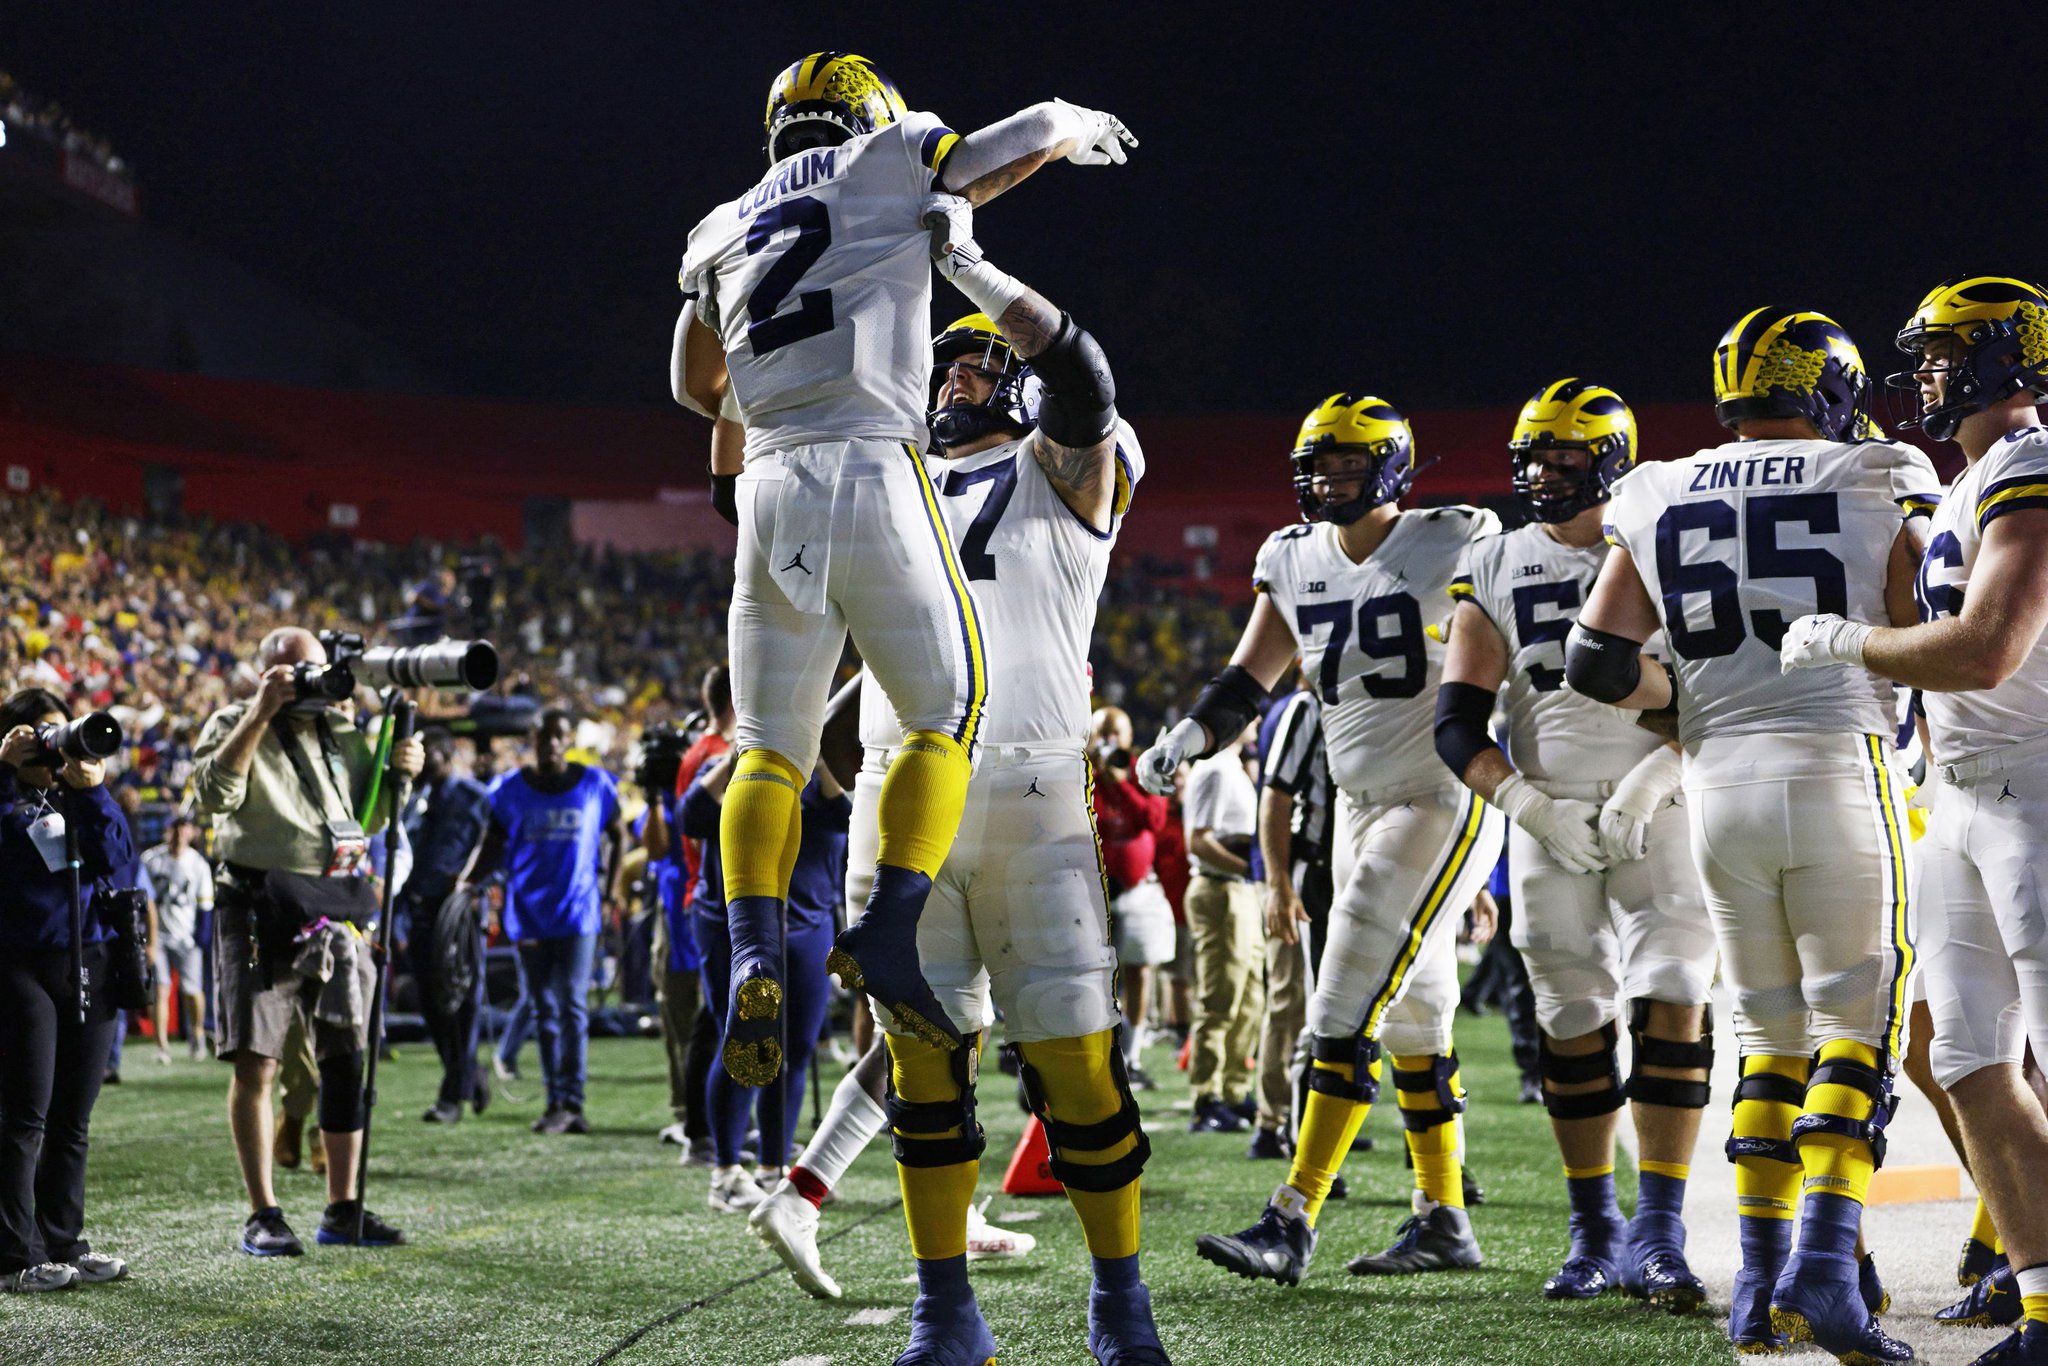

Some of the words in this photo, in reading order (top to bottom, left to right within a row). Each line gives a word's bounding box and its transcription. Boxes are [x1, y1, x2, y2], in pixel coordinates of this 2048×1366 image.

[738, 151, 835, 219] CORUM
[745, 195, 835, 357] 2
[933, 451, 1018, 582] 7
[1689, 456, 1805, 492] ZINTER
[1655, 492, 1847, 660] 65
[1296, 591, 1427, 706] 79
[1512, 578, 1597, 692] 5
[1571, 634, 1604, 651] ueller
